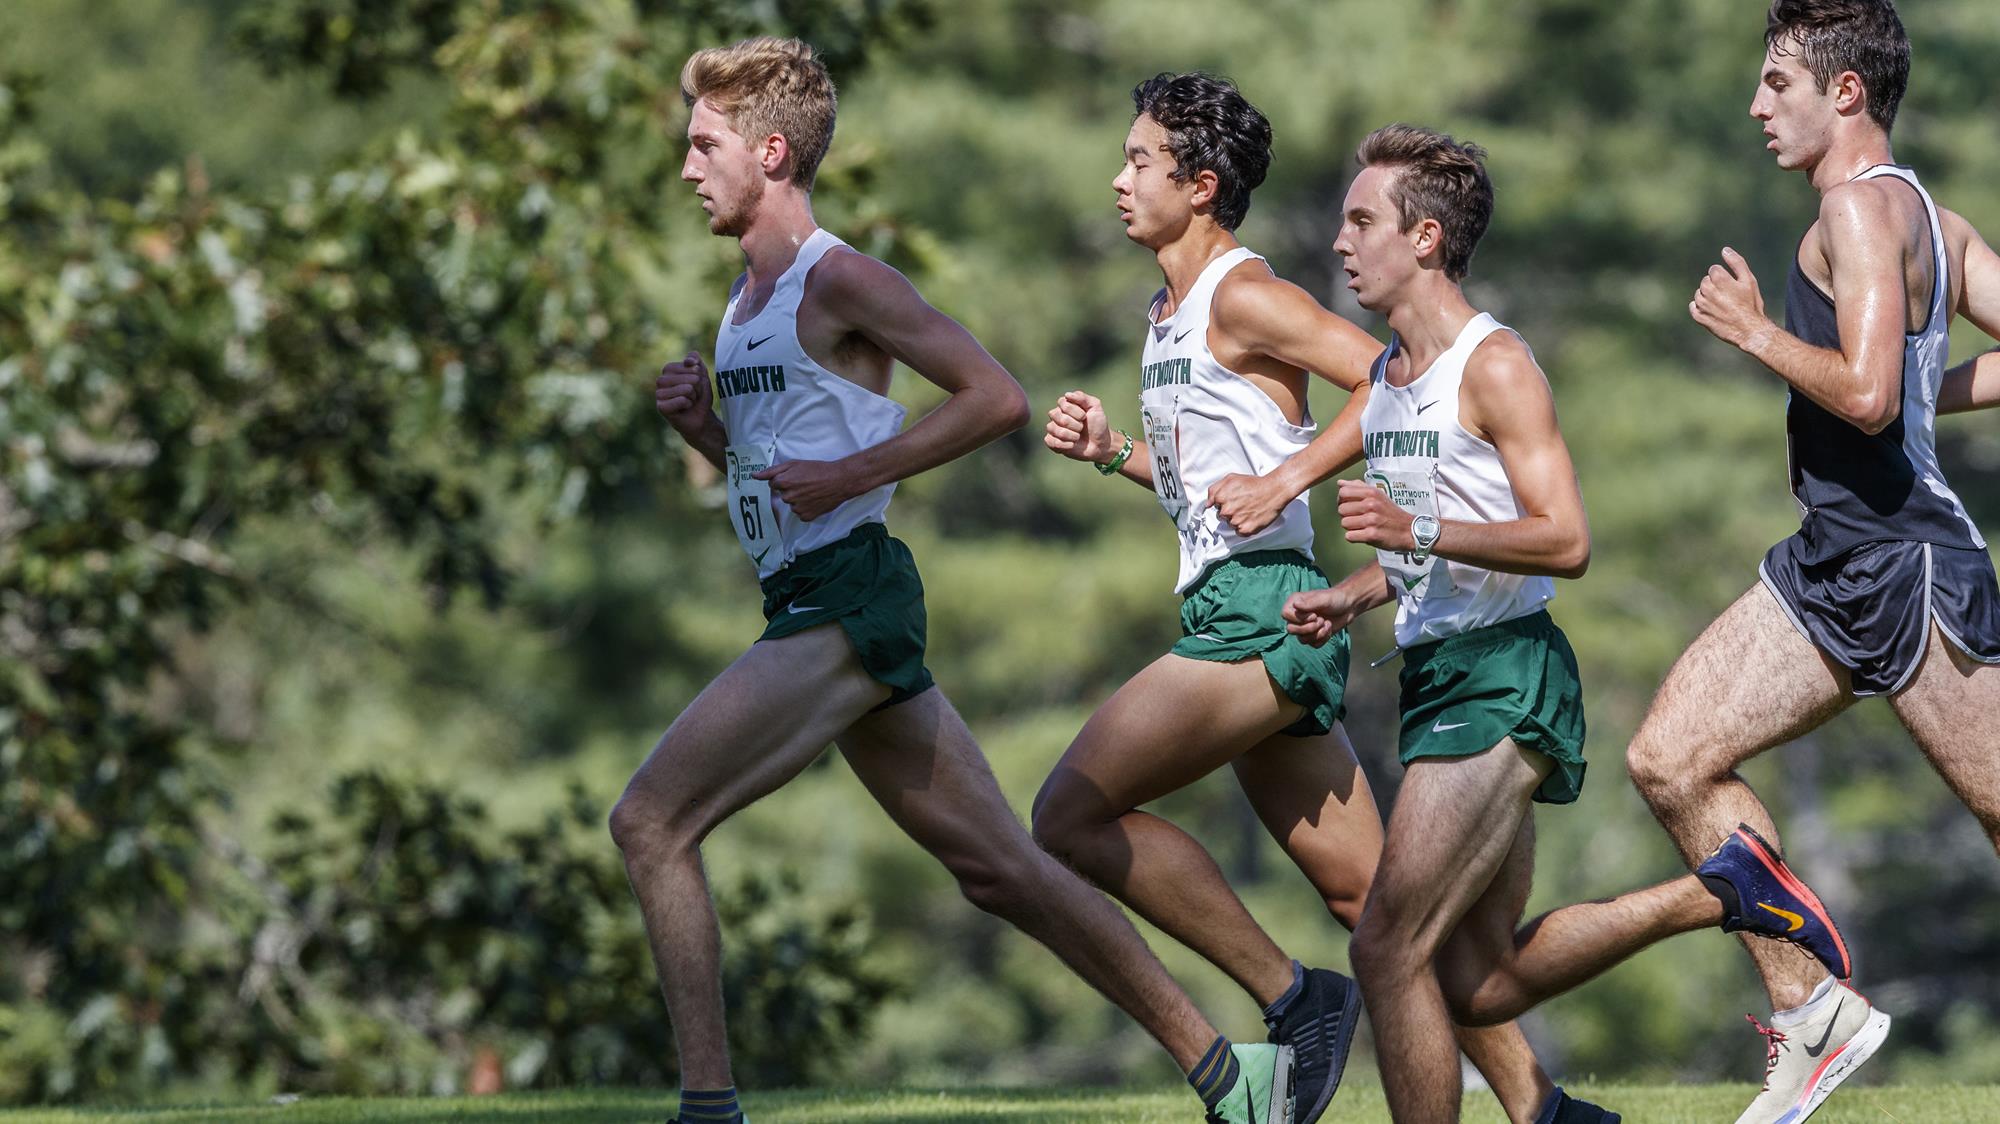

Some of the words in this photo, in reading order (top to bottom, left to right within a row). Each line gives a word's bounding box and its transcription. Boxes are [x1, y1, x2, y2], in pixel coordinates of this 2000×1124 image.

[1141, 358, 1191, 391] ARTMOUTH
[1365, 430, 1439, 460] DARTMOUTH
[1157, 456, 1177, 500] 65
[1393, 490, 1430, 499] DARTMOUTH
[1395, 498, 1416, 506] RELAYS
[739, 495, 764, 540] 67
